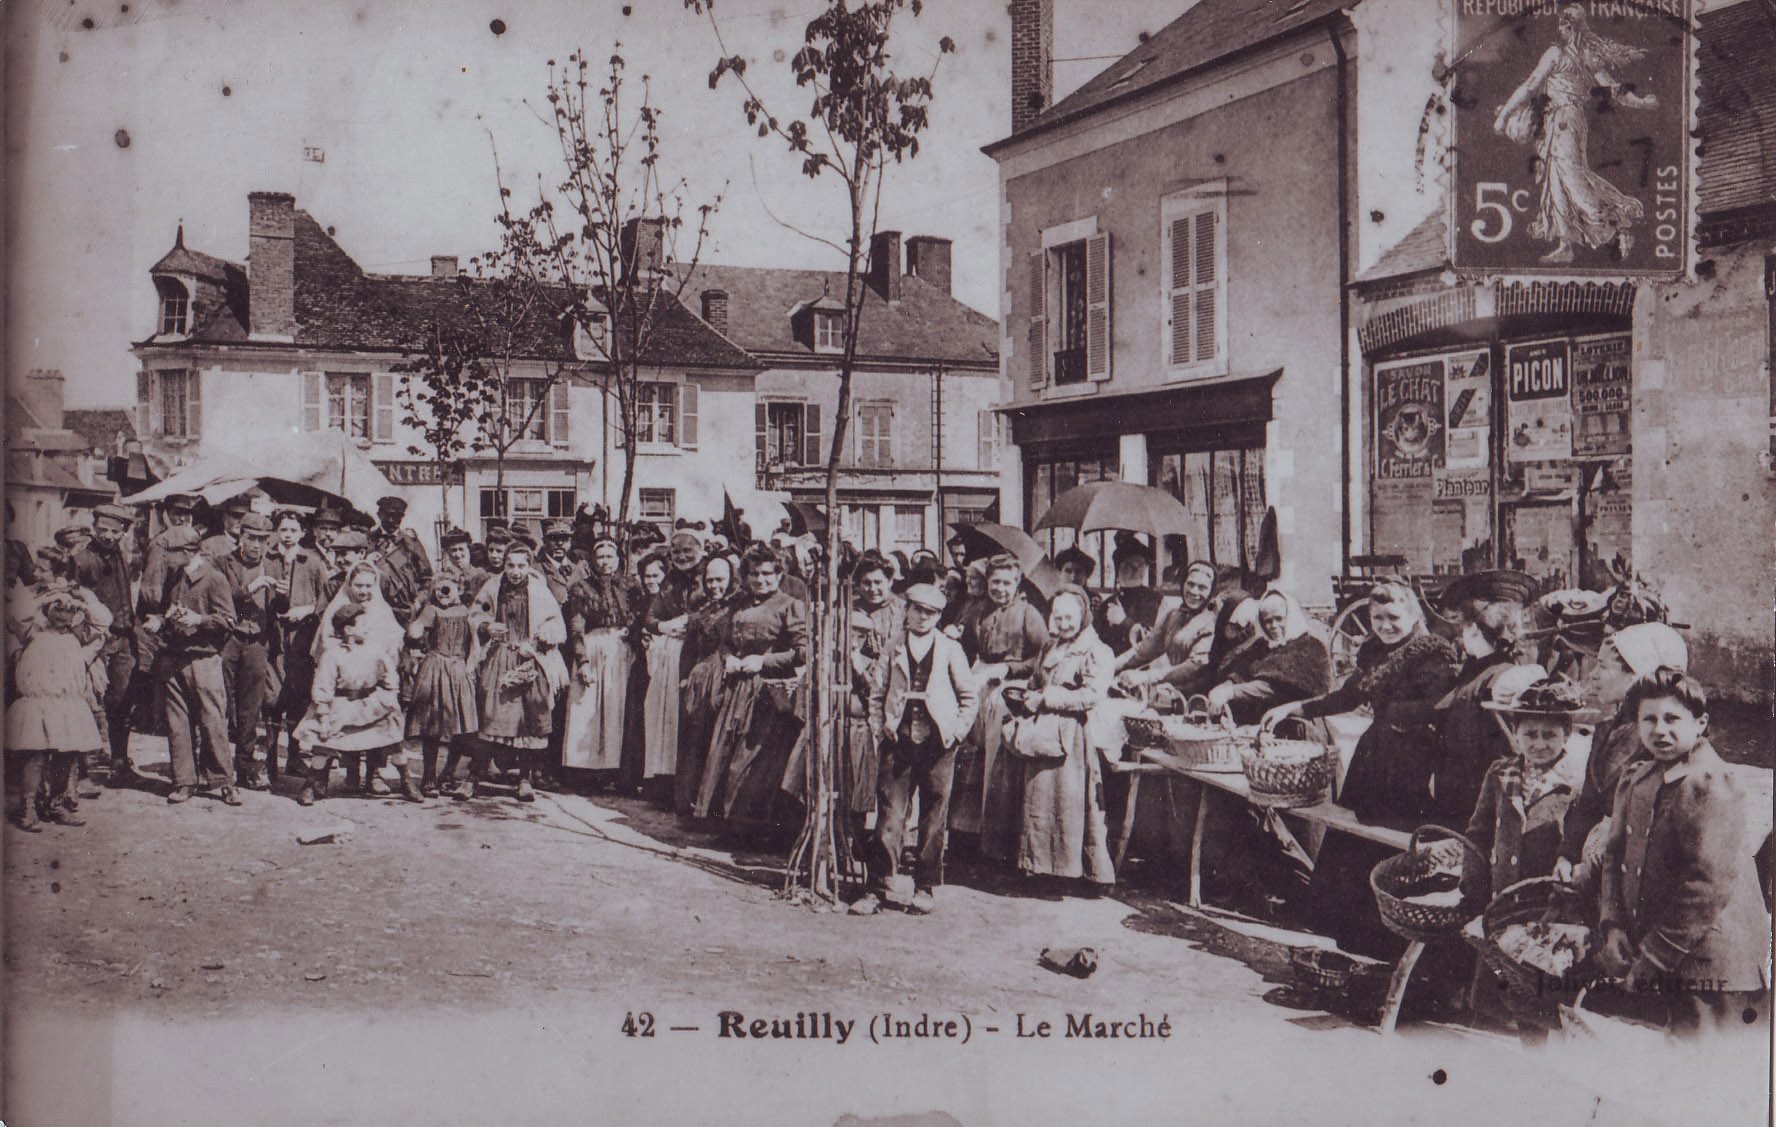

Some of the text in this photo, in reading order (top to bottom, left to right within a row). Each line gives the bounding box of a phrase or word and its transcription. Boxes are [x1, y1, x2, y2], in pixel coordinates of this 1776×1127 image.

[1655, 165, 1679, 259] POSTES
[1390, 364, 1432, 380] SAVON
[1513, 357, 1563, 394] PICON
[1379, 376, 1441, 412] LE CHAT
[1437, 478, 1489, 498] Planteur
